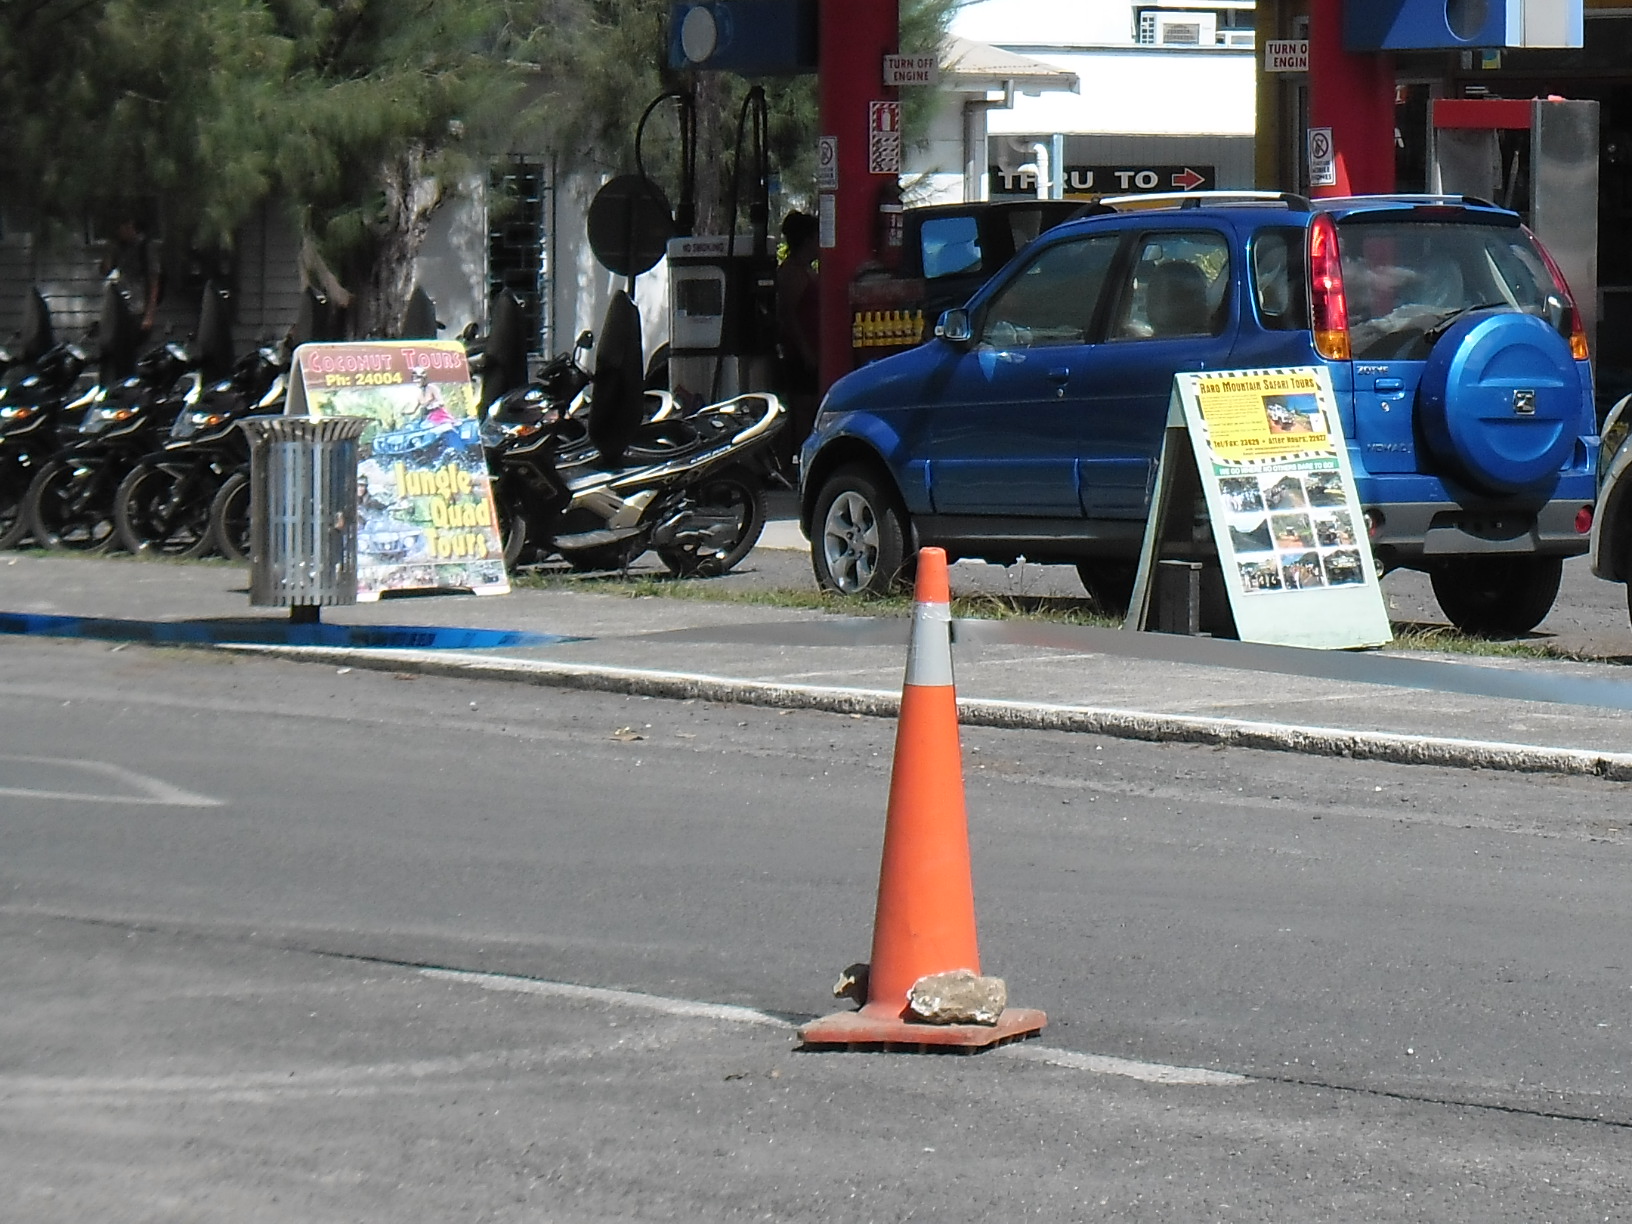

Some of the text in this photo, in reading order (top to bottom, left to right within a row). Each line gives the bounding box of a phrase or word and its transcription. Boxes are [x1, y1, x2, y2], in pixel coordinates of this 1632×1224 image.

[1268, 43, 1297, 55] TURN
[889, 58, 934, 70] TURN OFF
[1274, 57, 1307, 68] ENGIN
[893, 71, 929, 82] ENGINE
[998, 171, 1159, 190] THU TO
[309, 348, 463, 373] COCONUT TOURS
[325, 372, 403, 387] Ph: 24004
[1222, 381, 1262, 393] MOUNTAIN
[1263, 379, 1289, 390] SAFARI
[1290, 378, 1315, 389] TOURS
[393, 460, 473, 500] Jungle
[430, 494, 492, 530] Quad
[425, 528, 489, 559] Tours
